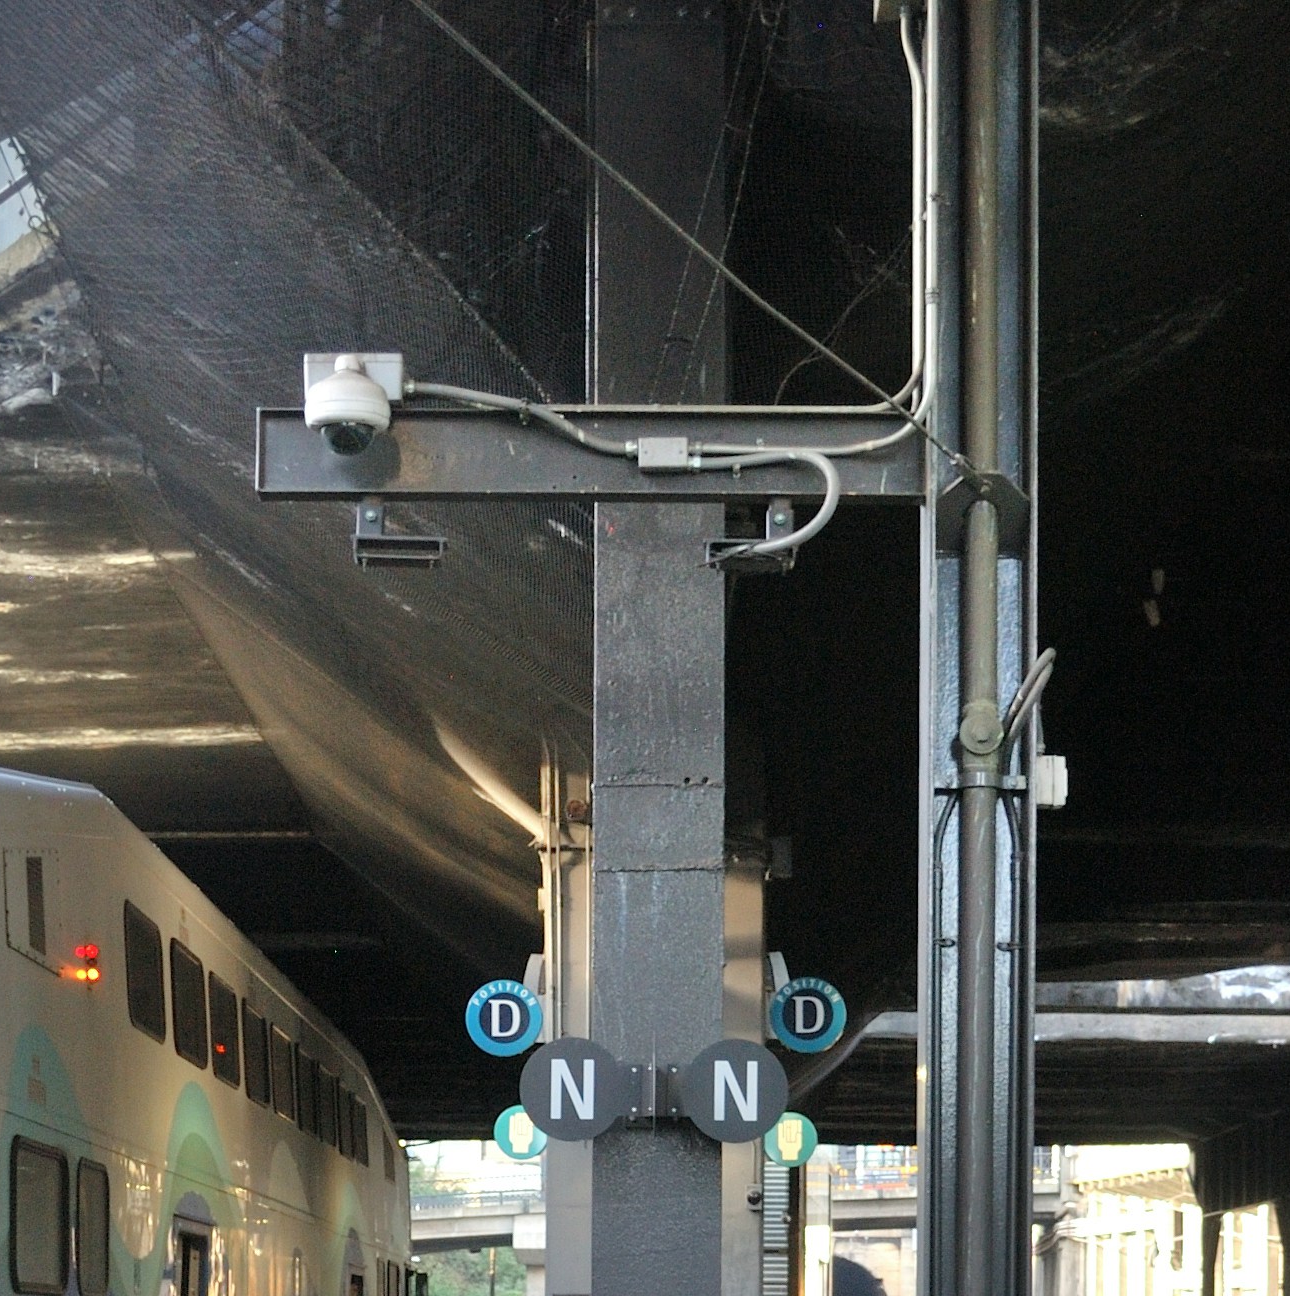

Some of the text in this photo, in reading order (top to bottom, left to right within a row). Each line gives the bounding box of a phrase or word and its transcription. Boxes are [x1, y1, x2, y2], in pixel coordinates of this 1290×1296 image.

[471, 982, 537, 1006] POSITION
[776, 979, 841, 1002] POSITION
[488, 998, 521, 1037] D
[791, 995, 825, 1034] D
[550, 1058, 595, 1120] N
[714, 1060, 758, 1122] N
